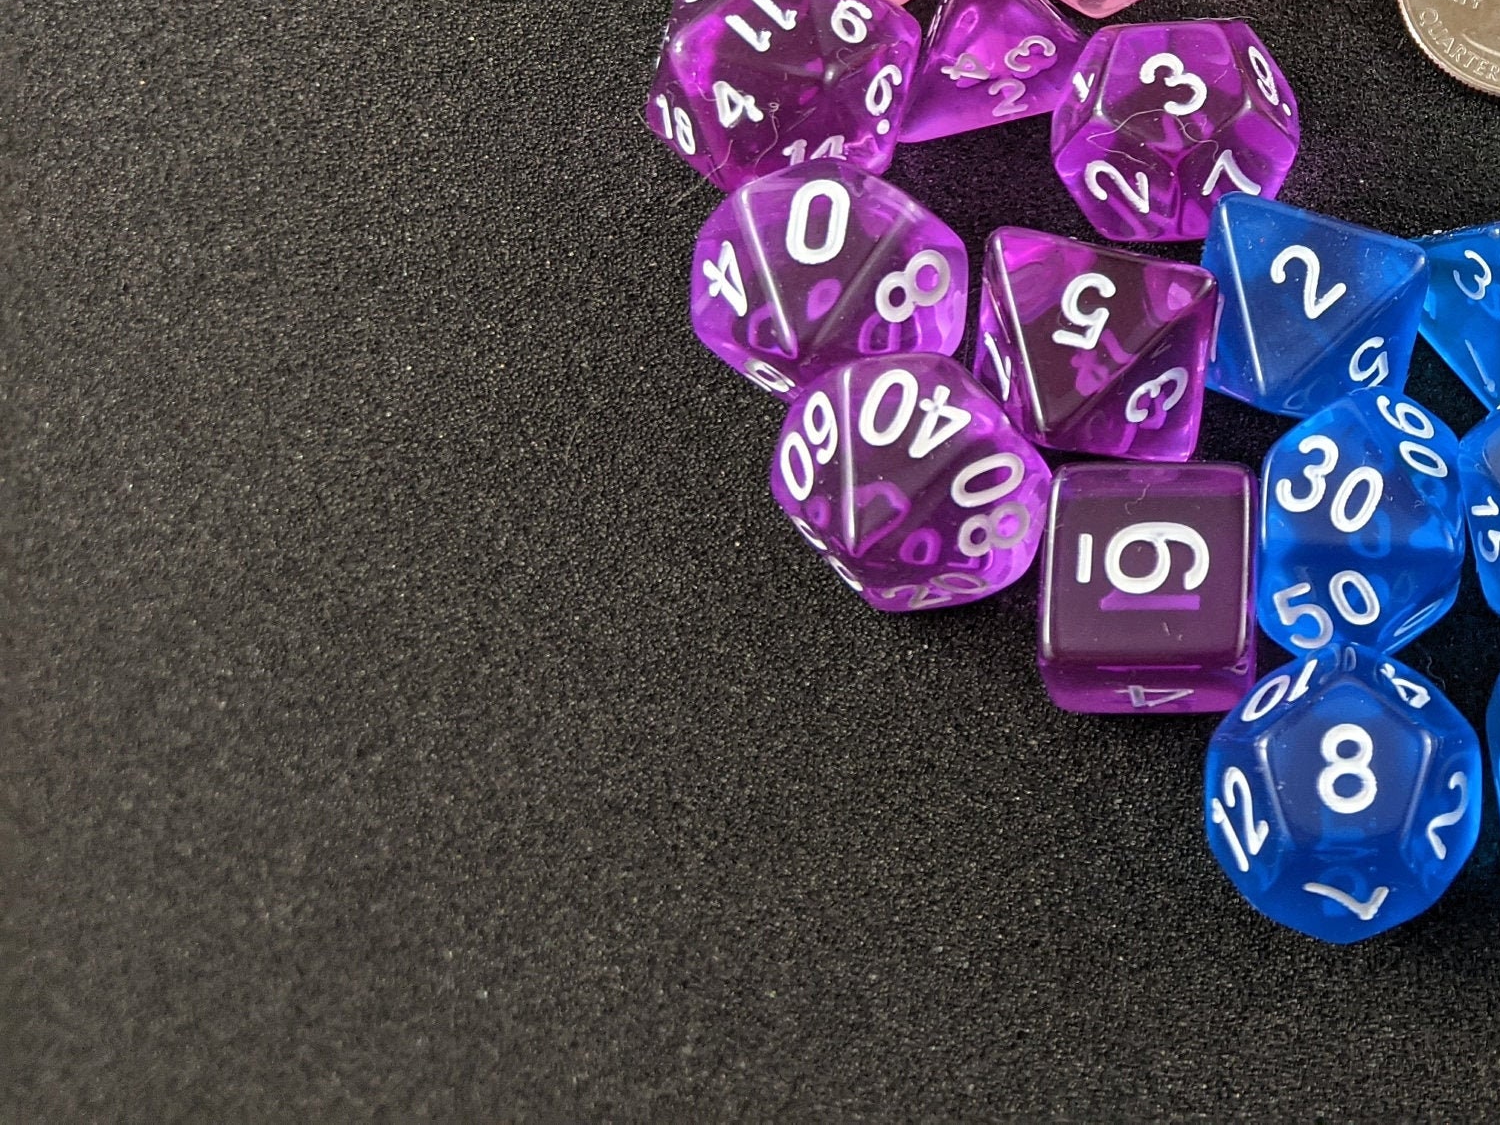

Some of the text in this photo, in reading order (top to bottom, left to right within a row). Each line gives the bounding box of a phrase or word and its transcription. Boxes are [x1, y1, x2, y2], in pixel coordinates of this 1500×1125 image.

[1004, 34, 1057, 73] 3
[1418, 6, 1500, 83] QUARTER
[712, 79, 765, 129] 4
[987, 76, 1029, 118] 2
[1140, 52, 1208, 115] 3
[656, 92, 696, 156] 18
[1084, 159, 1150, 214] 2
[1202, 149, 1262, 196] 7
[785, 178, 850, 265] 0
[702, 240, 748, 317] 4
[875, 249, 950, 322] 8
[1051, 272, 1117, 350] 5
[1269, 244, 1347, 320] 2
[1452, 249, 1492, 301] 3
[857, 368, 972, 459] 40
[1125, 366, 1189, 423] 3
[950, 451, 1031, 557] 80
[1275, 434, 1384, 533] 30
[1272, 569, 1381, 649] 50
[1240, 659, 1318, 722] 10
[1379, 663, 1431, 709] 4
[1318, 722, 1378, 815] 8
[1211, 765, 1270, 873] 12
